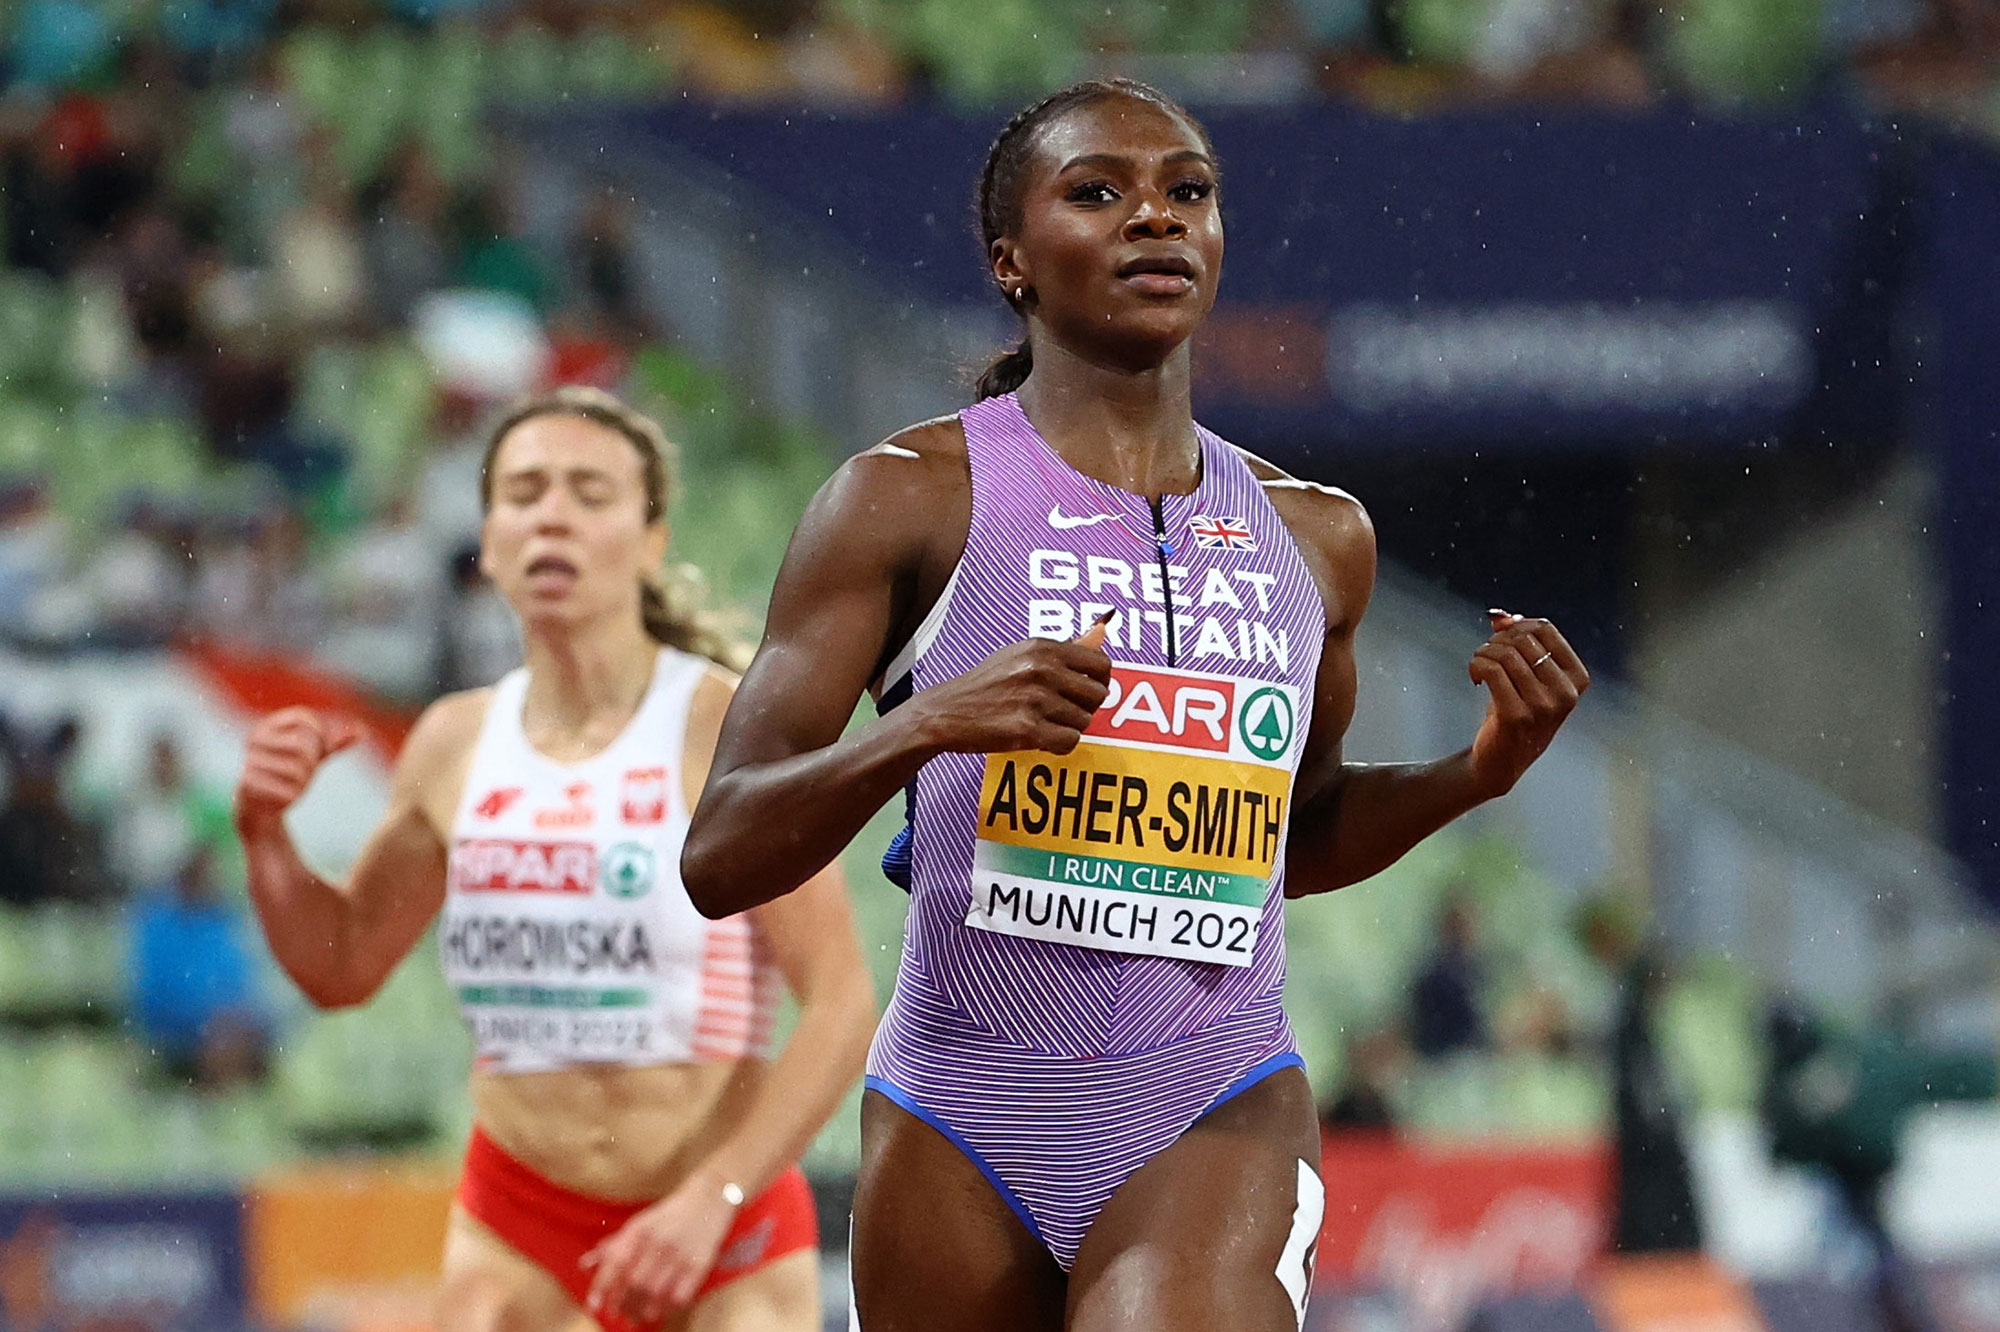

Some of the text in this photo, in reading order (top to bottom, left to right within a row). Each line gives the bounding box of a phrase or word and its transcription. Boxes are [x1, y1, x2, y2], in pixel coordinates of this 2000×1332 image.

[1029, 549, 1276, 612] GREAT
[986, 760, 1281, 863] ASHER-SMITH
[1048, 855, 1056, 877] I
[1065, 858, 1123, 886] RUN
[987, 883, 1260, 954] MUNICH 202
